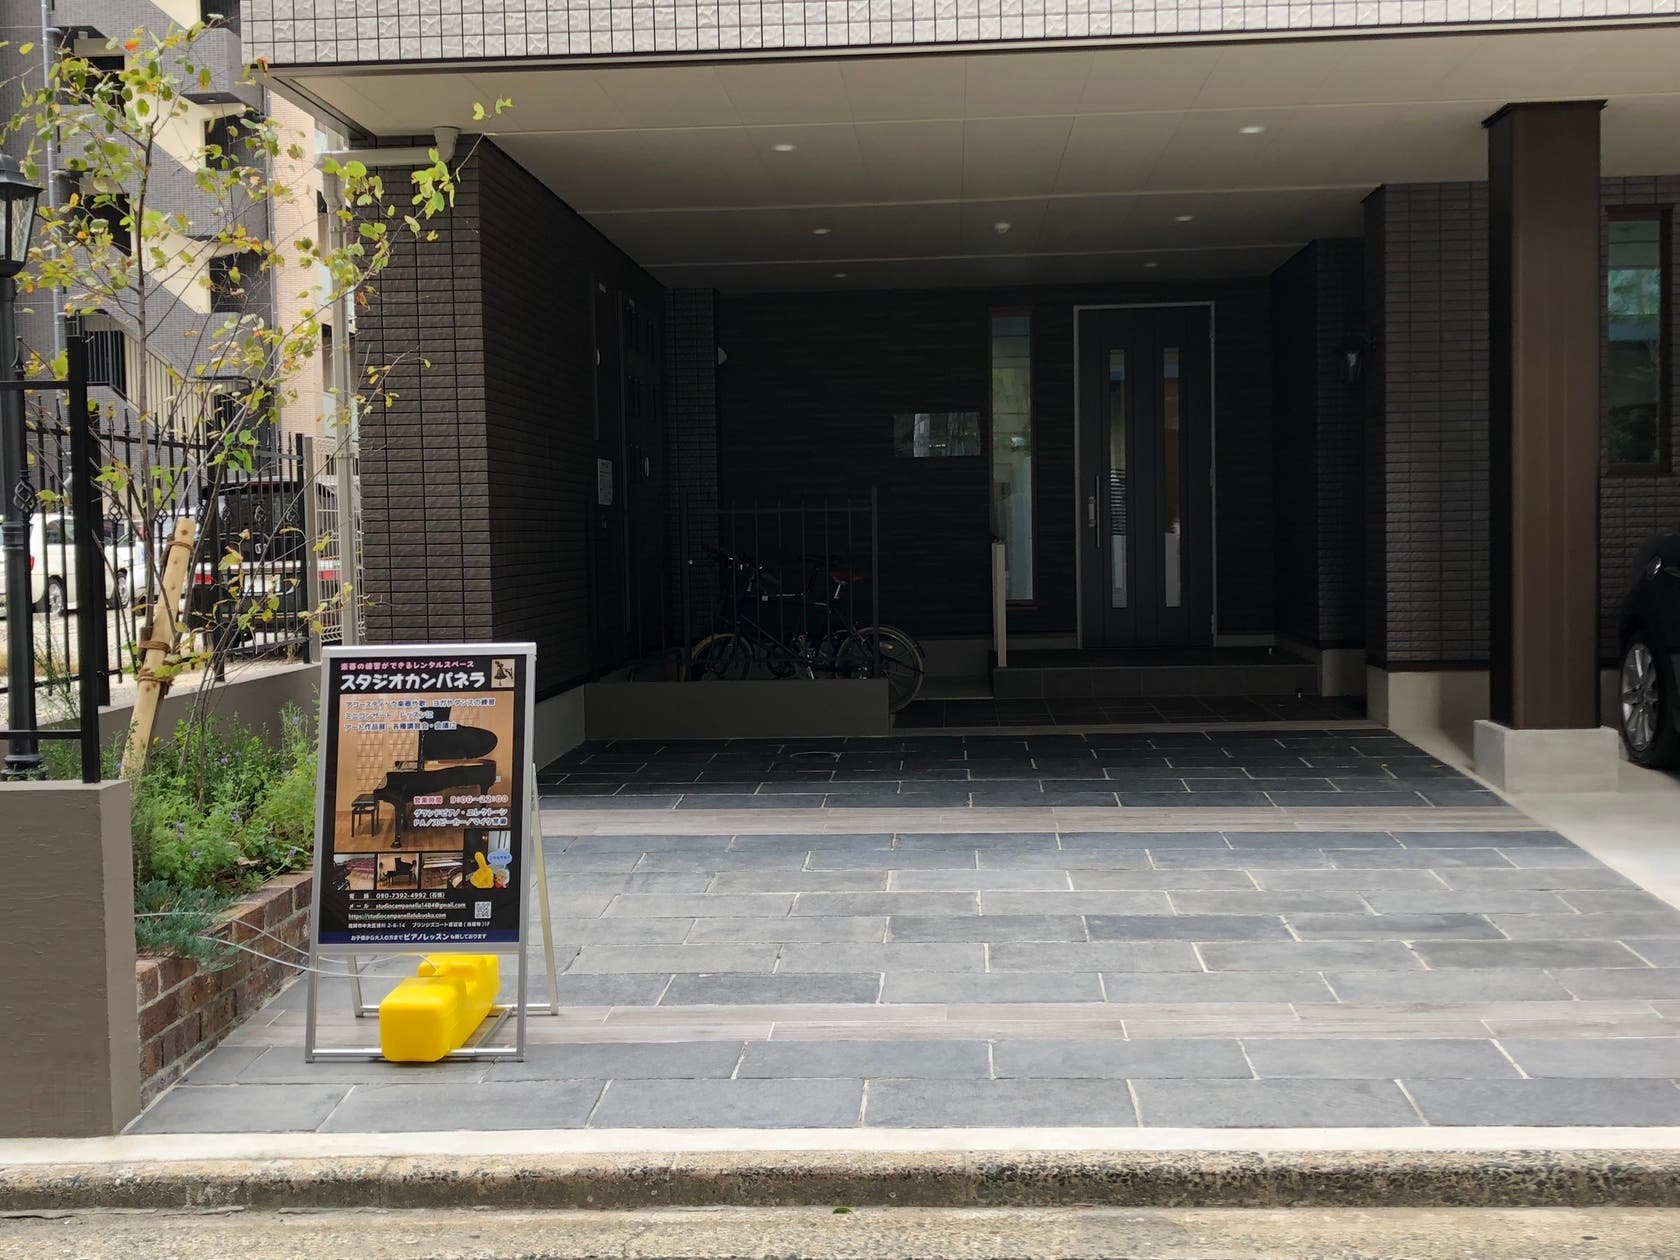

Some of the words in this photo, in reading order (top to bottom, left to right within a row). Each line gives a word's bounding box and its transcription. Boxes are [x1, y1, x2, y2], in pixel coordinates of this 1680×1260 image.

[340, 660, 475, 671] 楽器の練習ができるレンタルスペース
[340, 671, 486, 690] スタジオカンパネラ
[413, 795, 443, 805] 営業時間
[413, 808, 508, 818] グランドピアノ・エレクトーン
